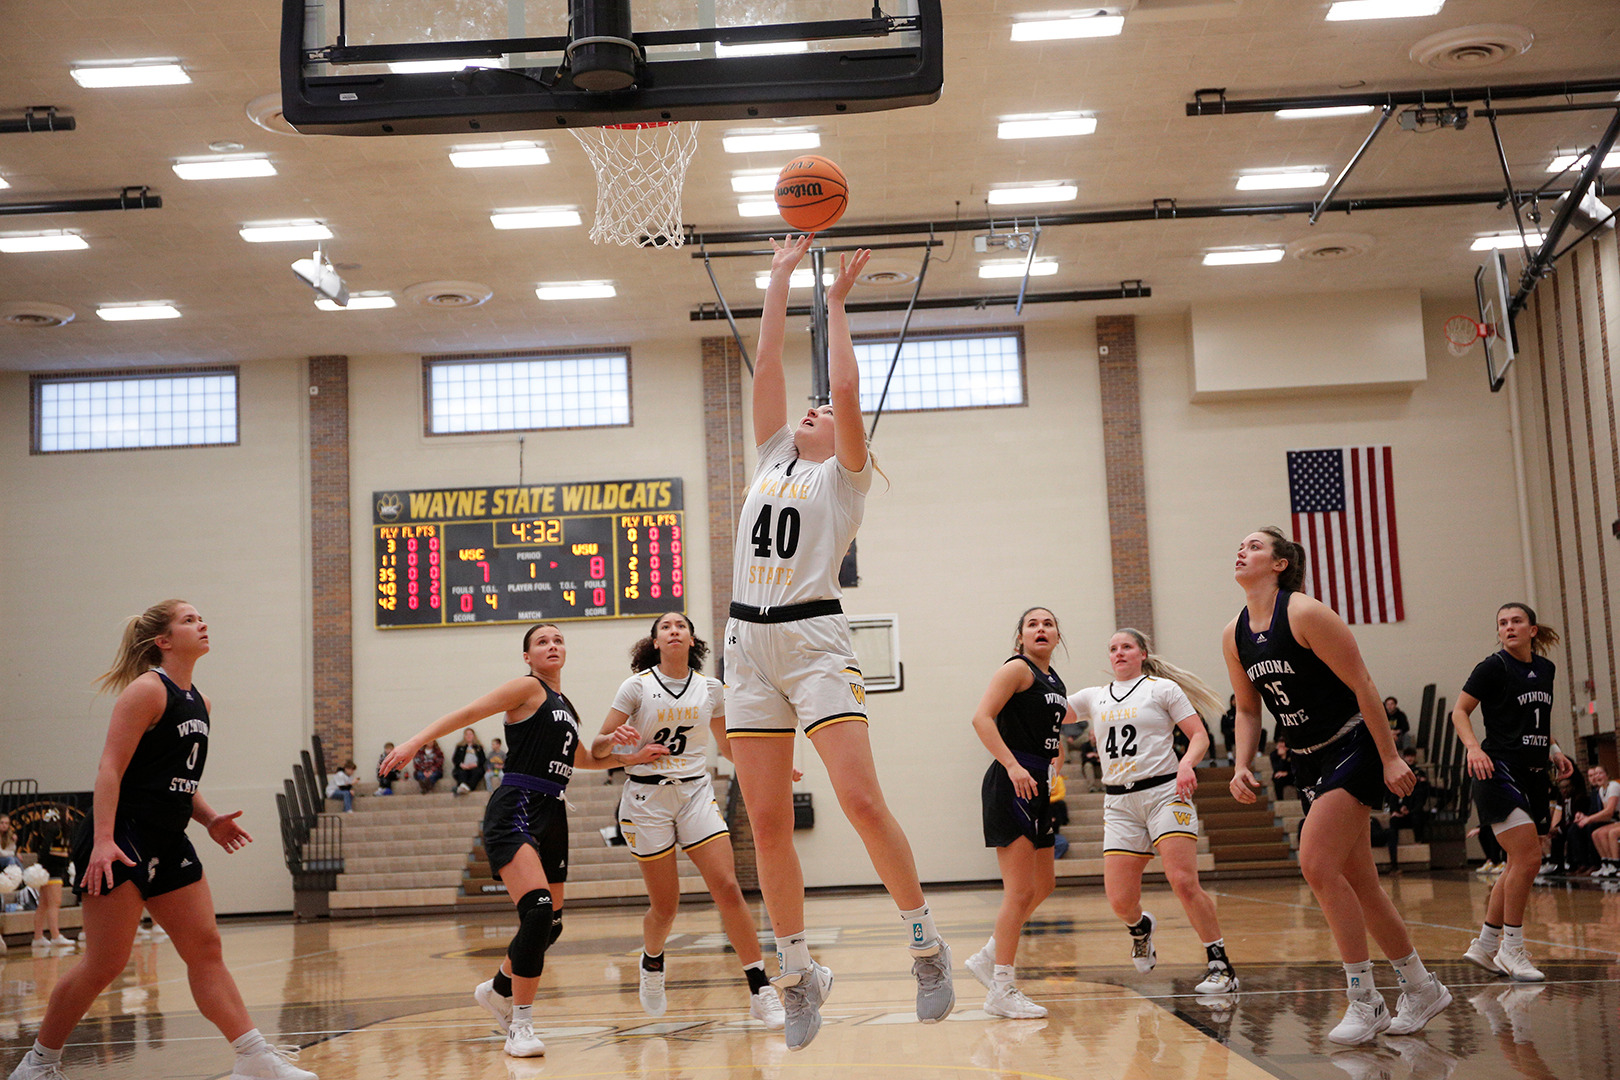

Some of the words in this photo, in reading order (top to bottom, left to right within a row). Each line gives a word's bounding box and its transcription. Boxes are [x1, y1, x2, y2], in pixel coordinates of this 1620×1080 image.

[778, 182, 824, 198] Wilson
[758, 478, 810, 500] WAYNE
[409, 491, 487, 518] WAYNE
[491, 487, 555, 514] STATE
[562, 482, 671, 511] WILDCATS
[622, 516, 640, 528] PLY
[657, 514, 677, 526] PTS
[380, 526, 399, 539] PLY
[416, 525, 436, 538] PTS
[511, 519, 561, 542] 4:32
[751, 504, 800, 560] 40
[387, 538, 396, 553] 3
[382, 554, 397, 566] 11
[516, 552, 542, 560] PERIOD
[628, 556, 638, 570] 2
[379, 567, 397, 582] 35
[476, 561, 490, 582] 7
[530, 562, 536, 578] 1
[590, 556, 605, 579] 8
[630, 570, 639, 585] 3
[749, 566, 794, 586] STATE
[378, 582, 397, 596] 40
[452, 586, 474, 594] FOULS
[508, 584, 532, 592] PLAYER
[534, 582, 552, 591] FOUL
[584, 580, 606, 588] FOULS
[563, 590, 576, 606] 4
[593, 588, 606, 606] 0
[624, 585, 639, 599] 15
[378, 596, 397, 610] 42
[460, 594, 473, 612] 0
[486, 594, 498, 610] 4
[453, 613, 476, 622] SCORE
[518, 611, 542, 620] MATCH
[584, 607, 607, 616] SCORE
[1247, 660, 1296, 682] WINONA
[1264, 680, 1290, 706] 15
[657, 706, 699, 722] WAYNE
[1100, 707, 1138, 722] WAYNE
[1280, 708, 1310, 726] TATE
[1534, 708, 1540, 729] 1
[562, 730, 573, 757] 2
[1106, 724, 1138, 760] 42
[1522, 735, 1548, 746] STATE
[186, 742, 200, 770] 0
[652, 758, 687, 770] STATE
[1108, 761, 1137, 774] STATE
[169, 777, 199, 795] STAT
